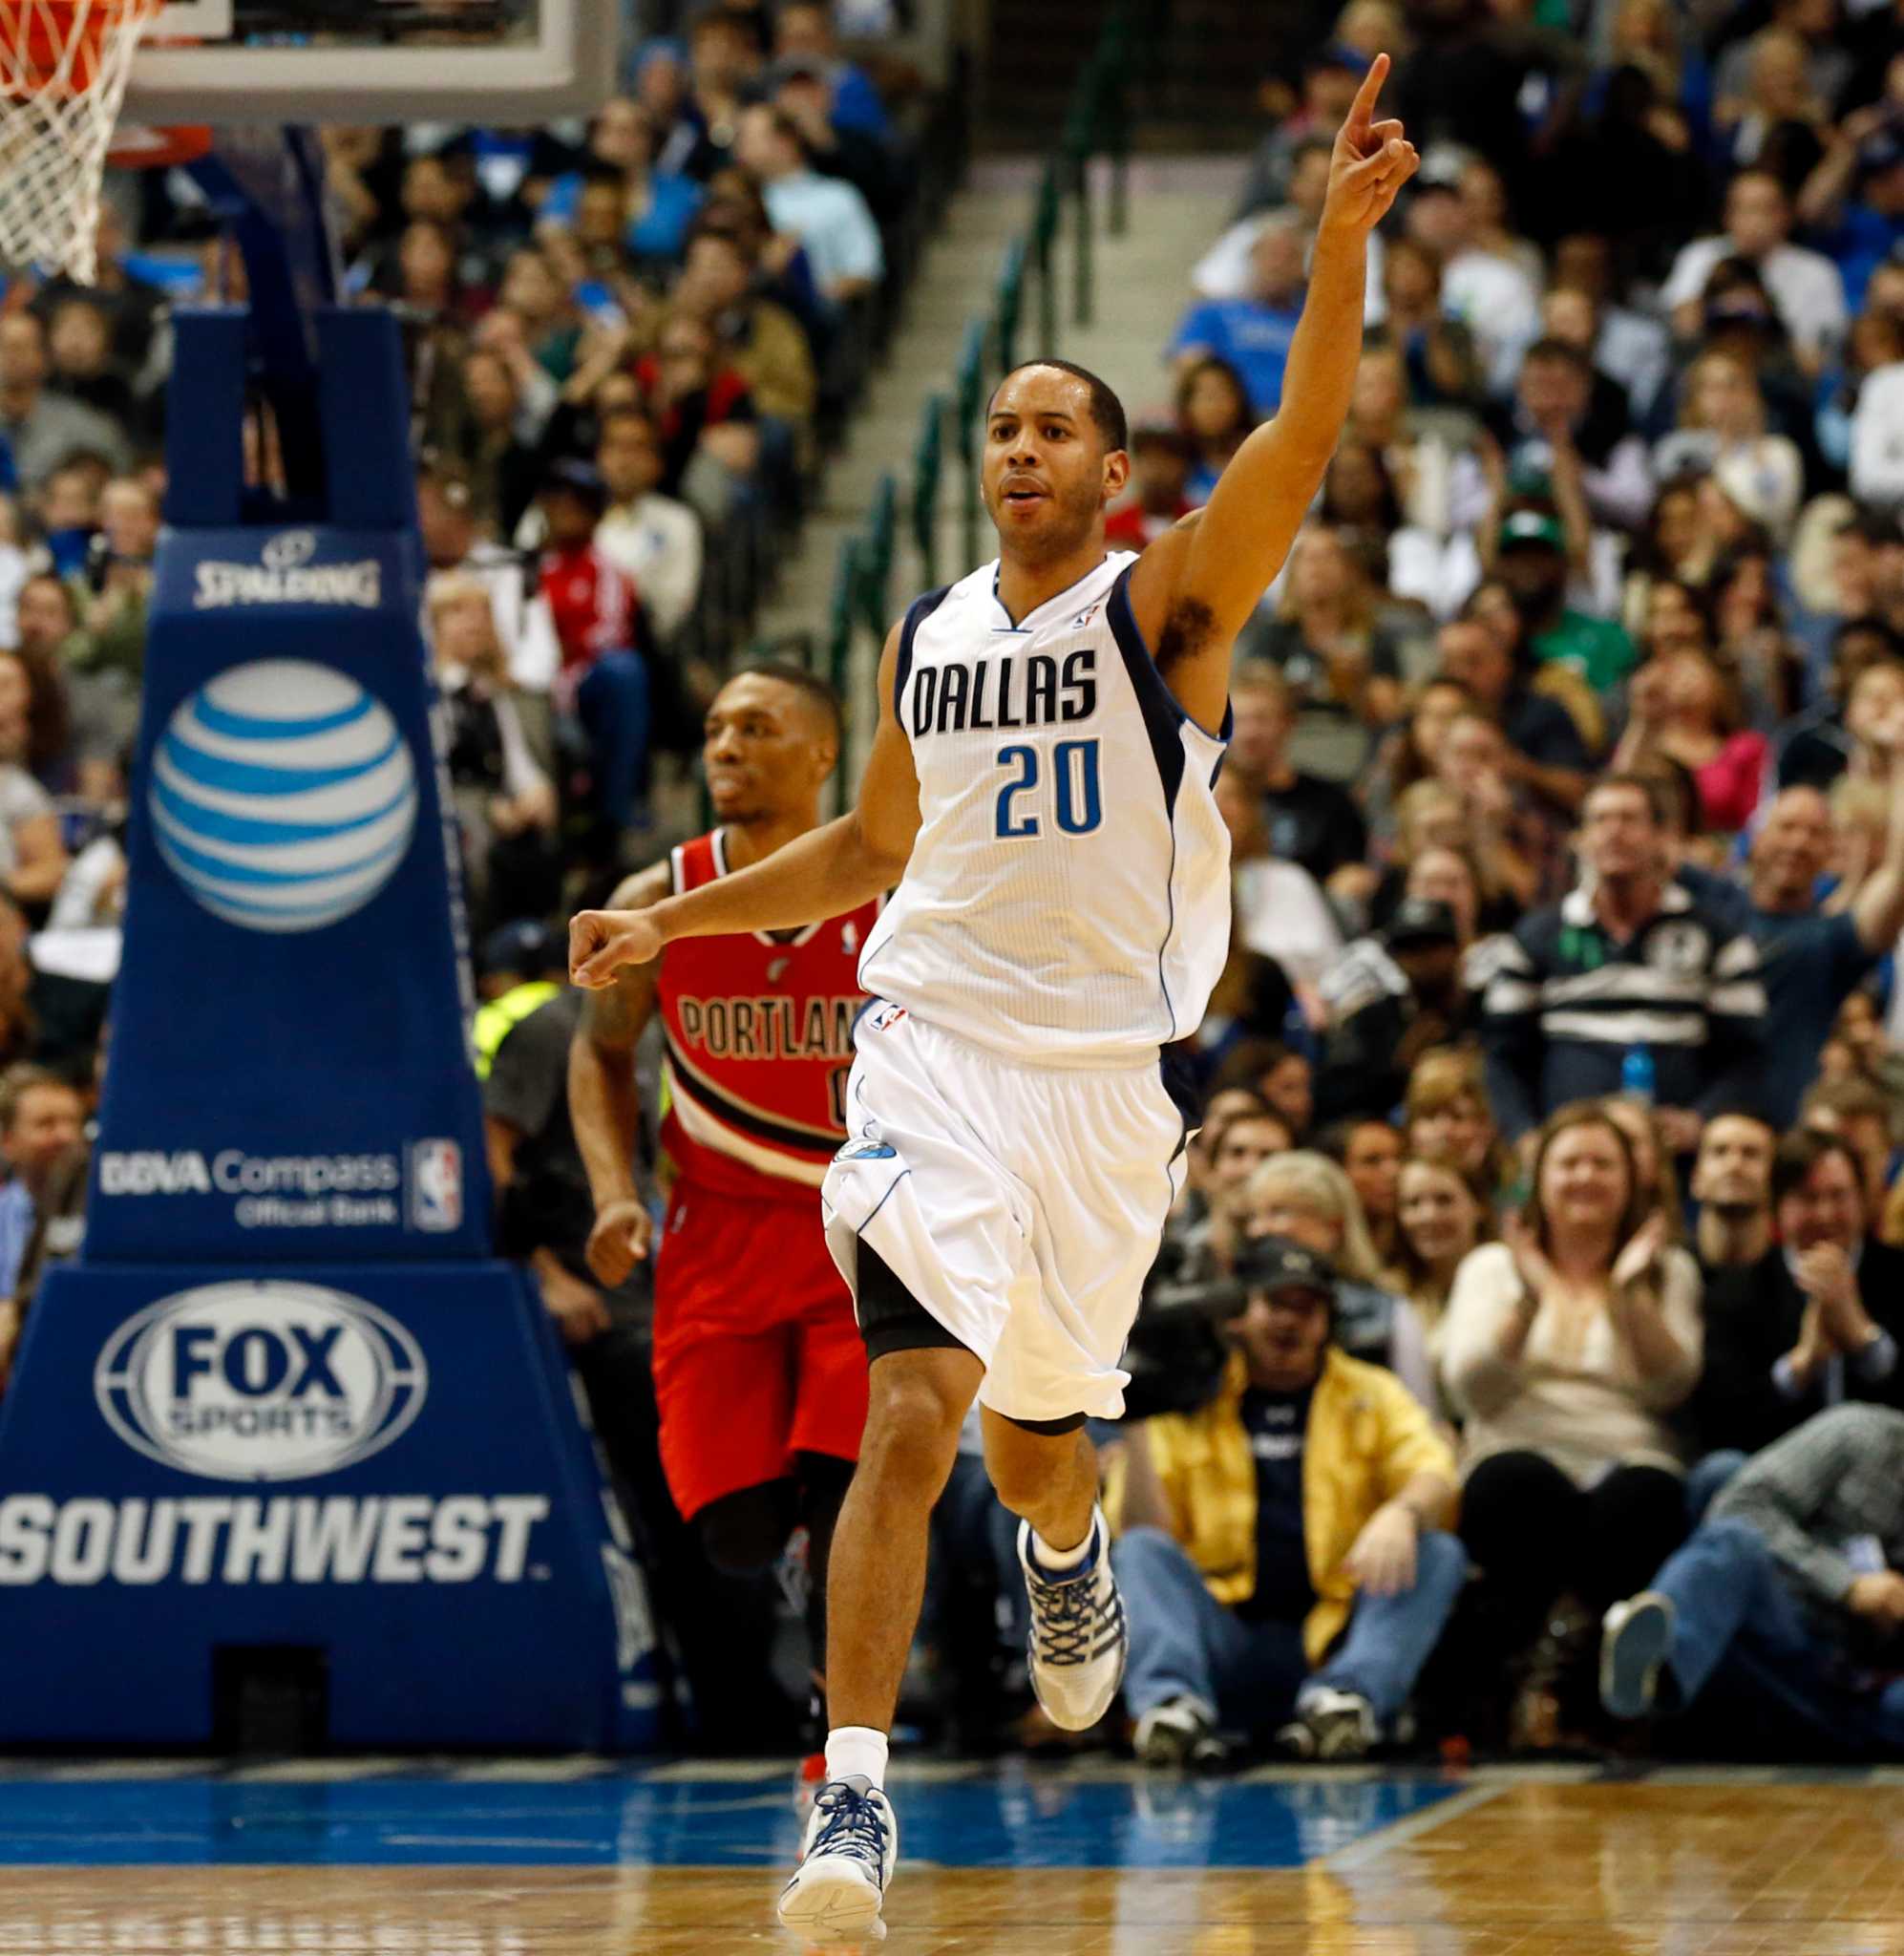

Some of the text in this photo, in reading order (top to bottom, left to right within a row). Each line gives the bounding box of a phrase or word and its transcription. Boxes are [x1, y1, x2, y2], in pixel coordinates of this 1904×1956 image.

[194, 560, 381, 609] SPALDING
[914, 649, 1096, 739] DALLAS
[995, 737, 1104, 839] 20
[678, 994, 867, 1060] PORTLAN
[100, 1149, 399, 1198] BBVA Compass
[235, 1196, 397, 1228] Official Bank
[172, 1325, 346, 1398] FOX
[169, 1404, 353, 1437] SPORTS
[0, 1494, 550, 1584] SOUTHWEST
